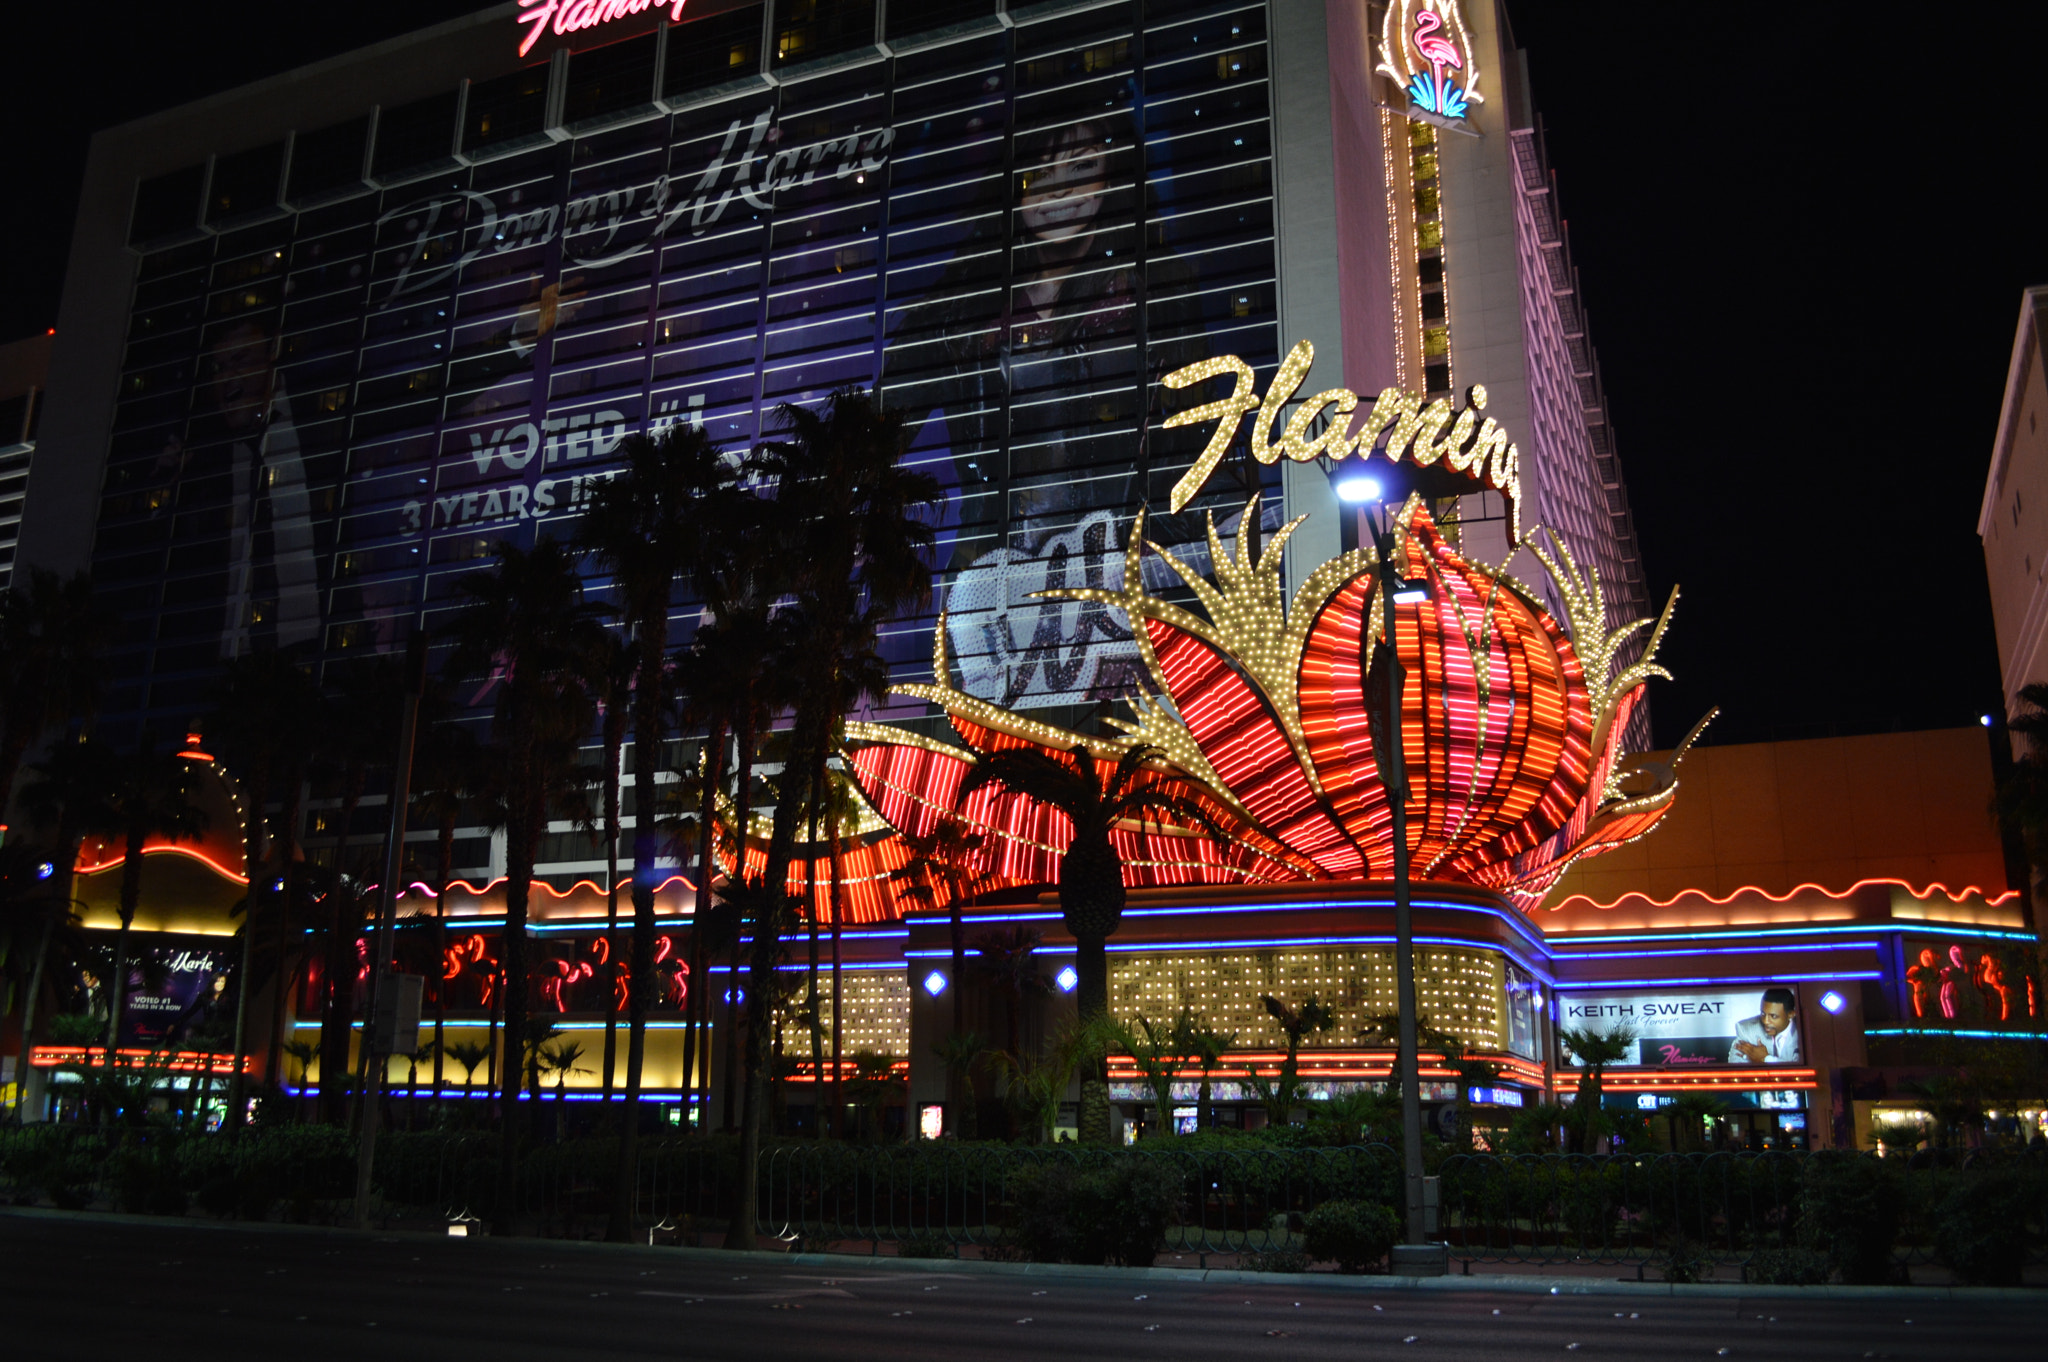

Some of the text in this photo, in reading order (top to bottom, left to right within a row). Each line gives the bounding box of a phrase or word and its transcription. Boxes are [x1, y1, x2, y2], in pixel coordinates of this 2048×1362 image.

[374, 105, 897, 310] Donny & Marie
[468, 393, 707, 475] VOTED #1
[401, 499, 423, 538] 3
[439, 478, 556, 530] YEARS
[134, 996, 160, 1004] VOTED
[1568, 1001, 1725, 1018] KEITH SWEAT
